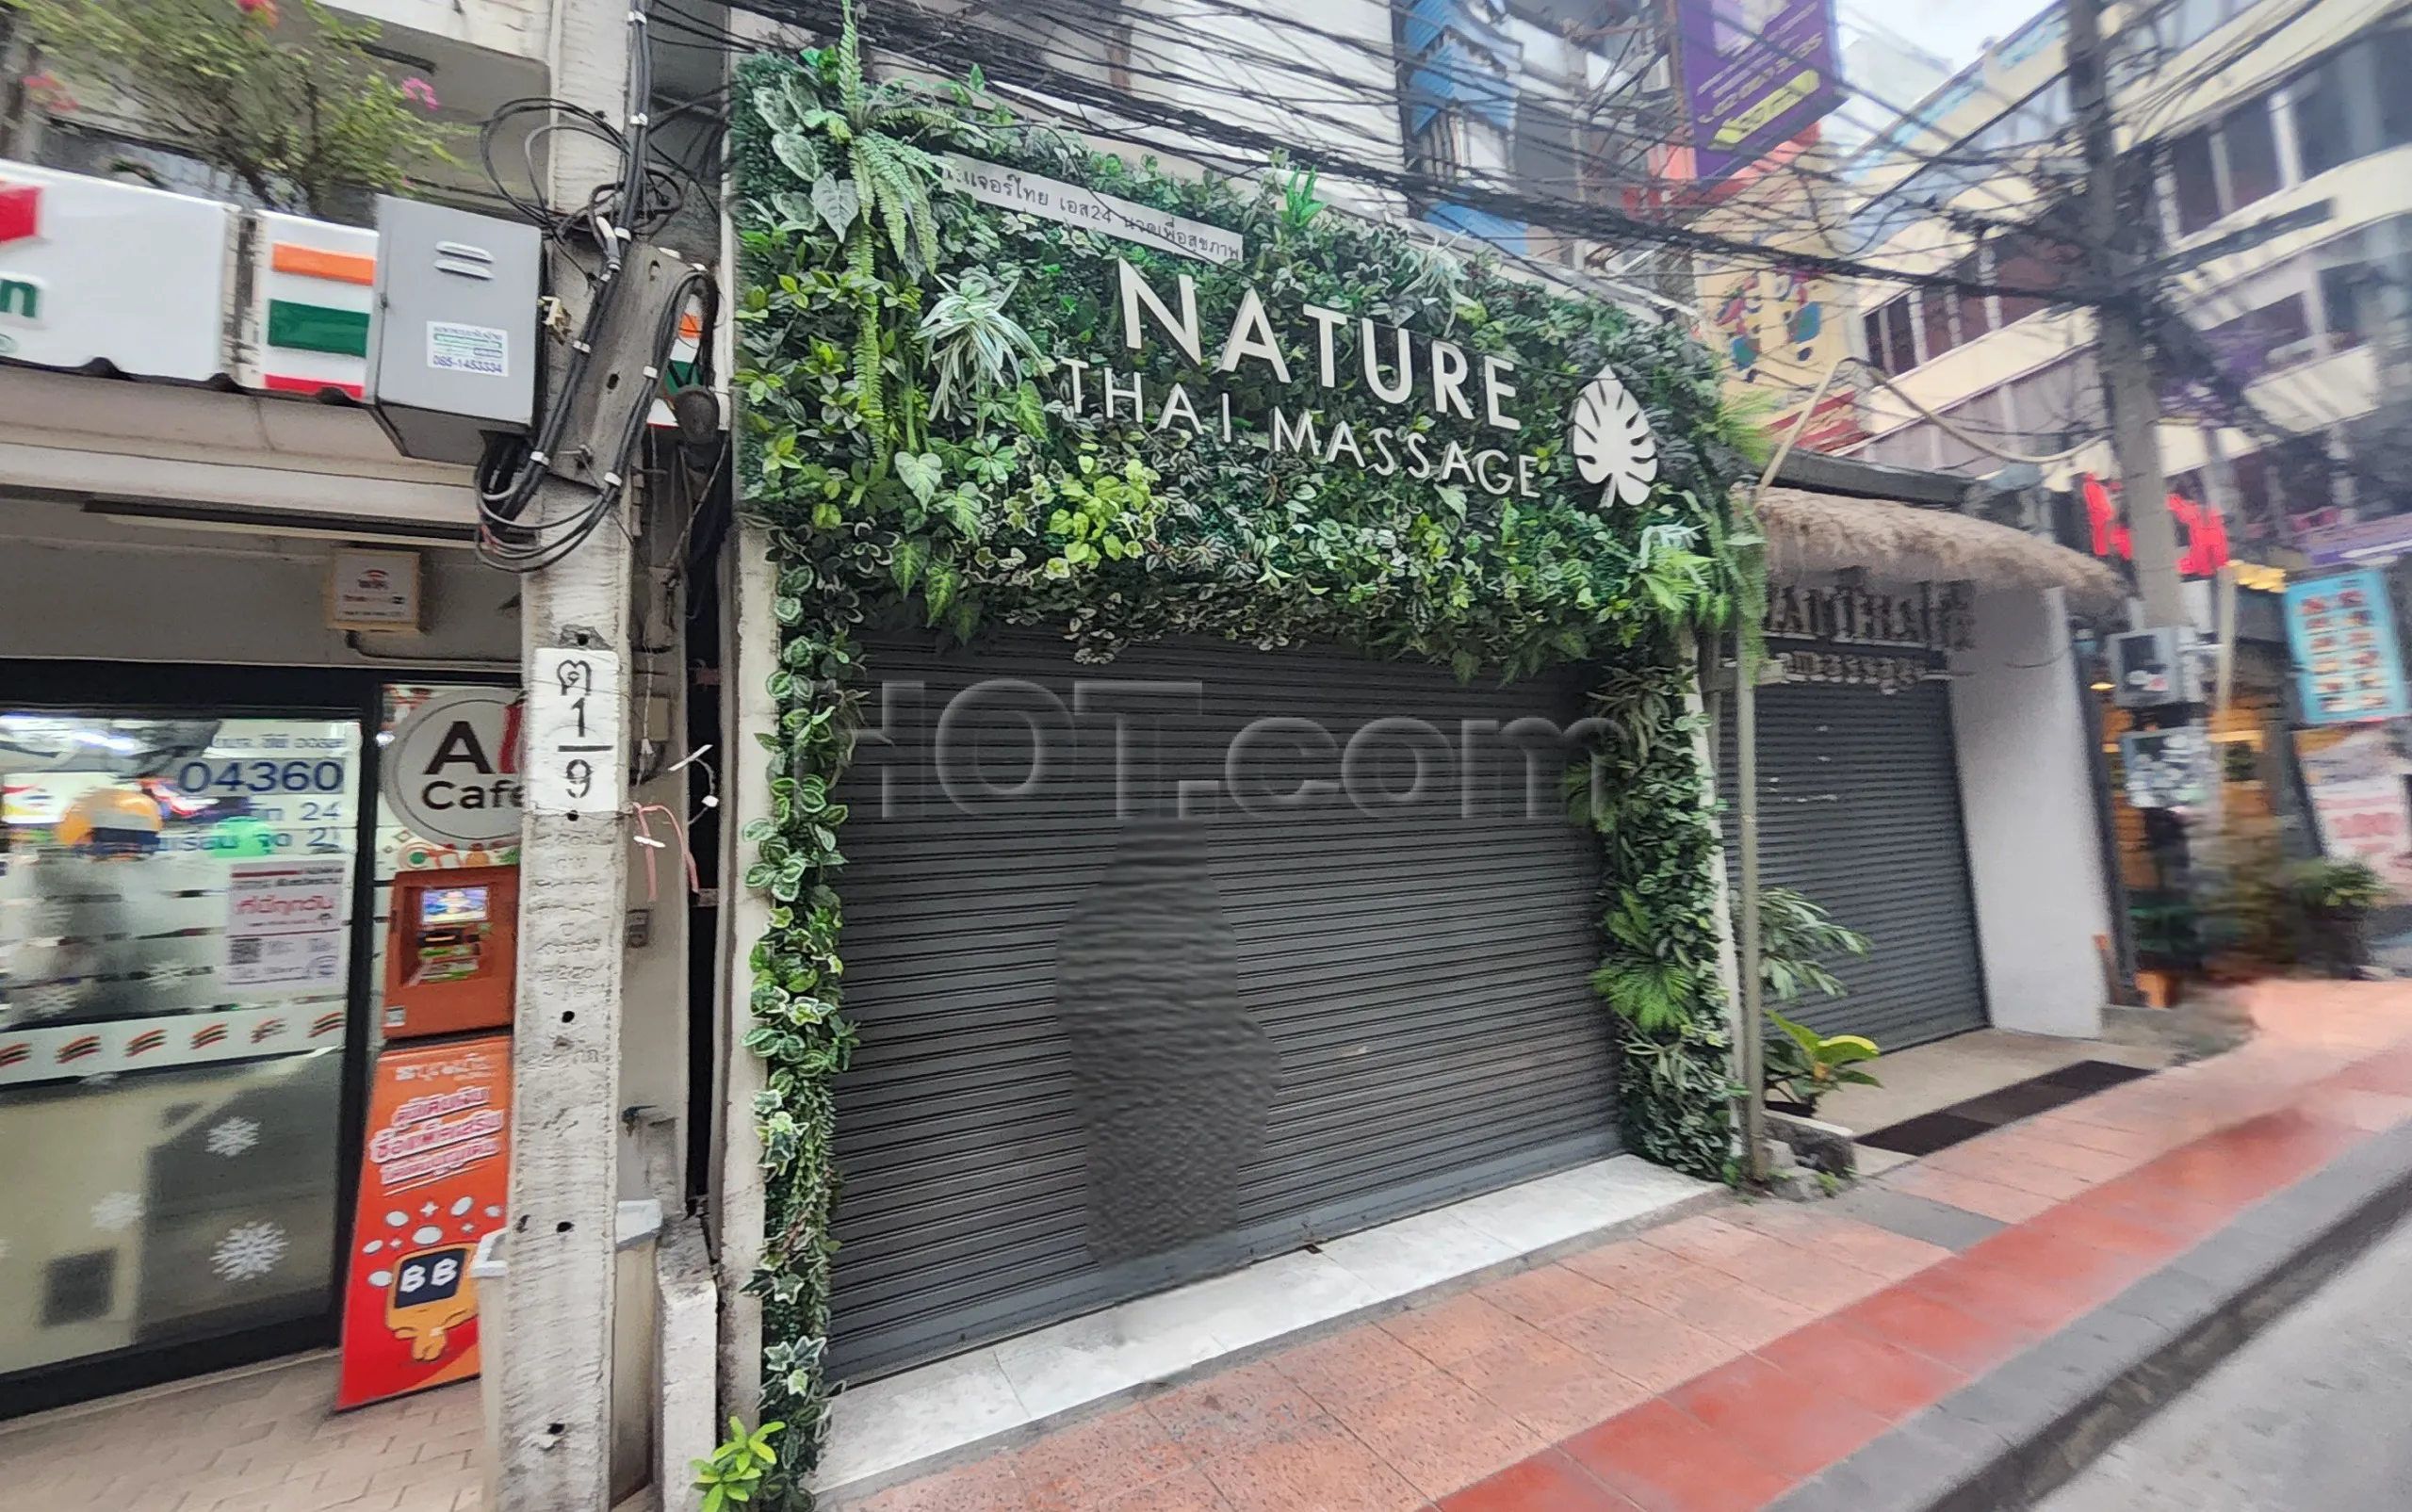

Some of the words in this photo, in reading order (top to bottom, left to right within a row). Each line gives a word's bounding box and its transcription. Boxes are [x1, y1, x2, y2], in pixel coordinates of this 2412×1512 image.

[1059, 195, 1113, 225] เอส24
[1118, 256, 1522, 432] NATURE
[1059, 357, 1232, 444] THAI
[1268, 406, 1542, 499] MASSAGE
[570, 697, 586, 738] 1
[177, 760, 345, 793] 04360
[565, 758, 593, 799] 9
